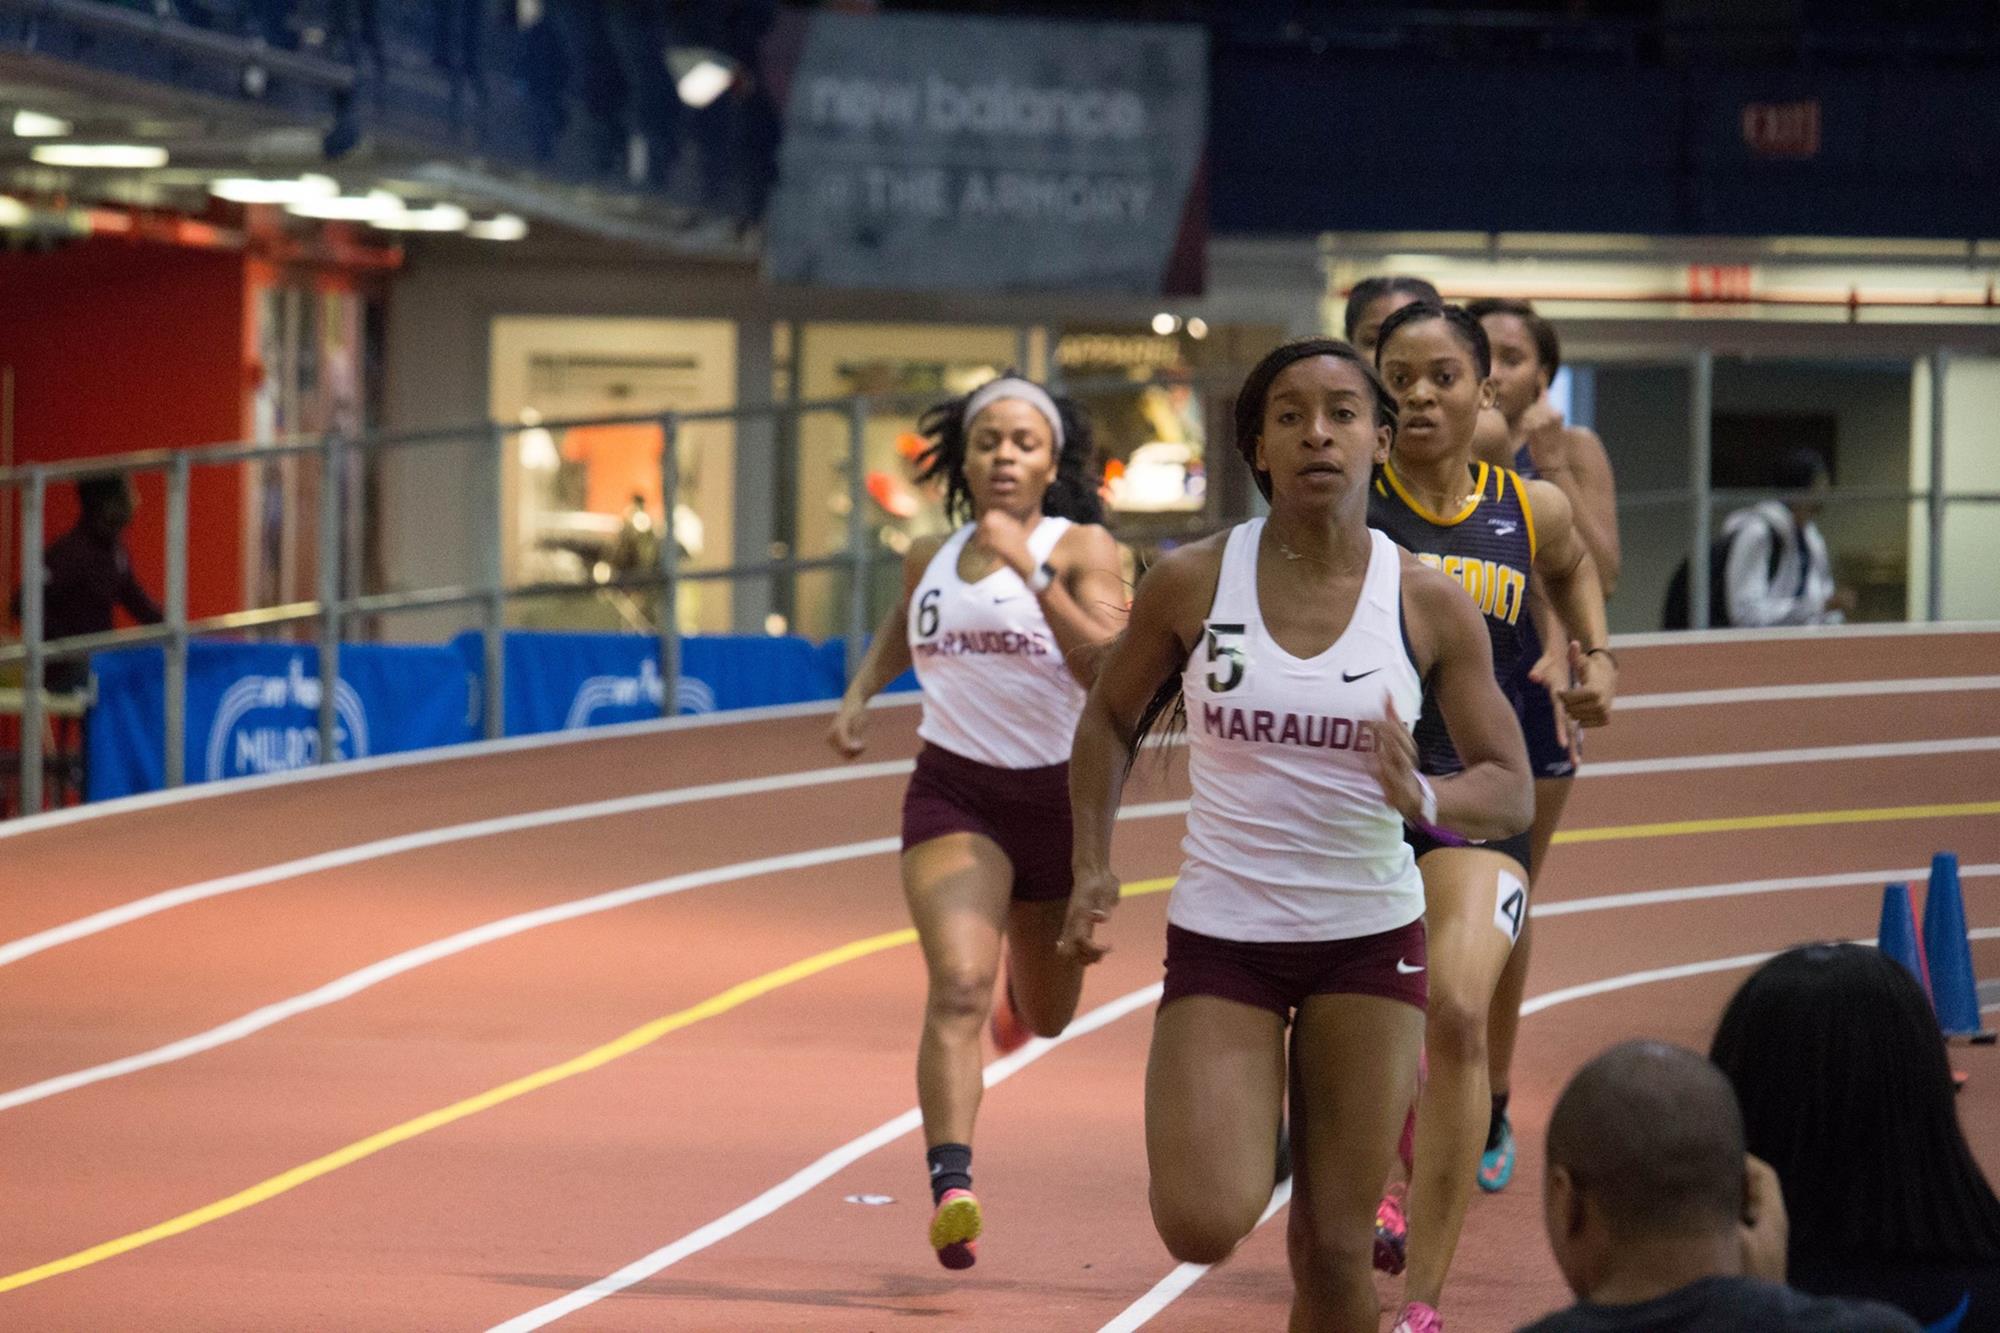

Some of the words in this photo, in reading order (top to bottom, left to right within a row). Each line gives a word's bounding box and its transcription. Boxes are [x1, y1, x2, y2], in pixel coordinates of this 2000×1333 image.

[918, 588, 941, 638] 6
[1206, 623, 1246, 693] 5
[235, 725, 348, 775] MILLROE
[1203, 702, 1408, 752] MARAUDE
[1501, 887, 1524, 940] 4
